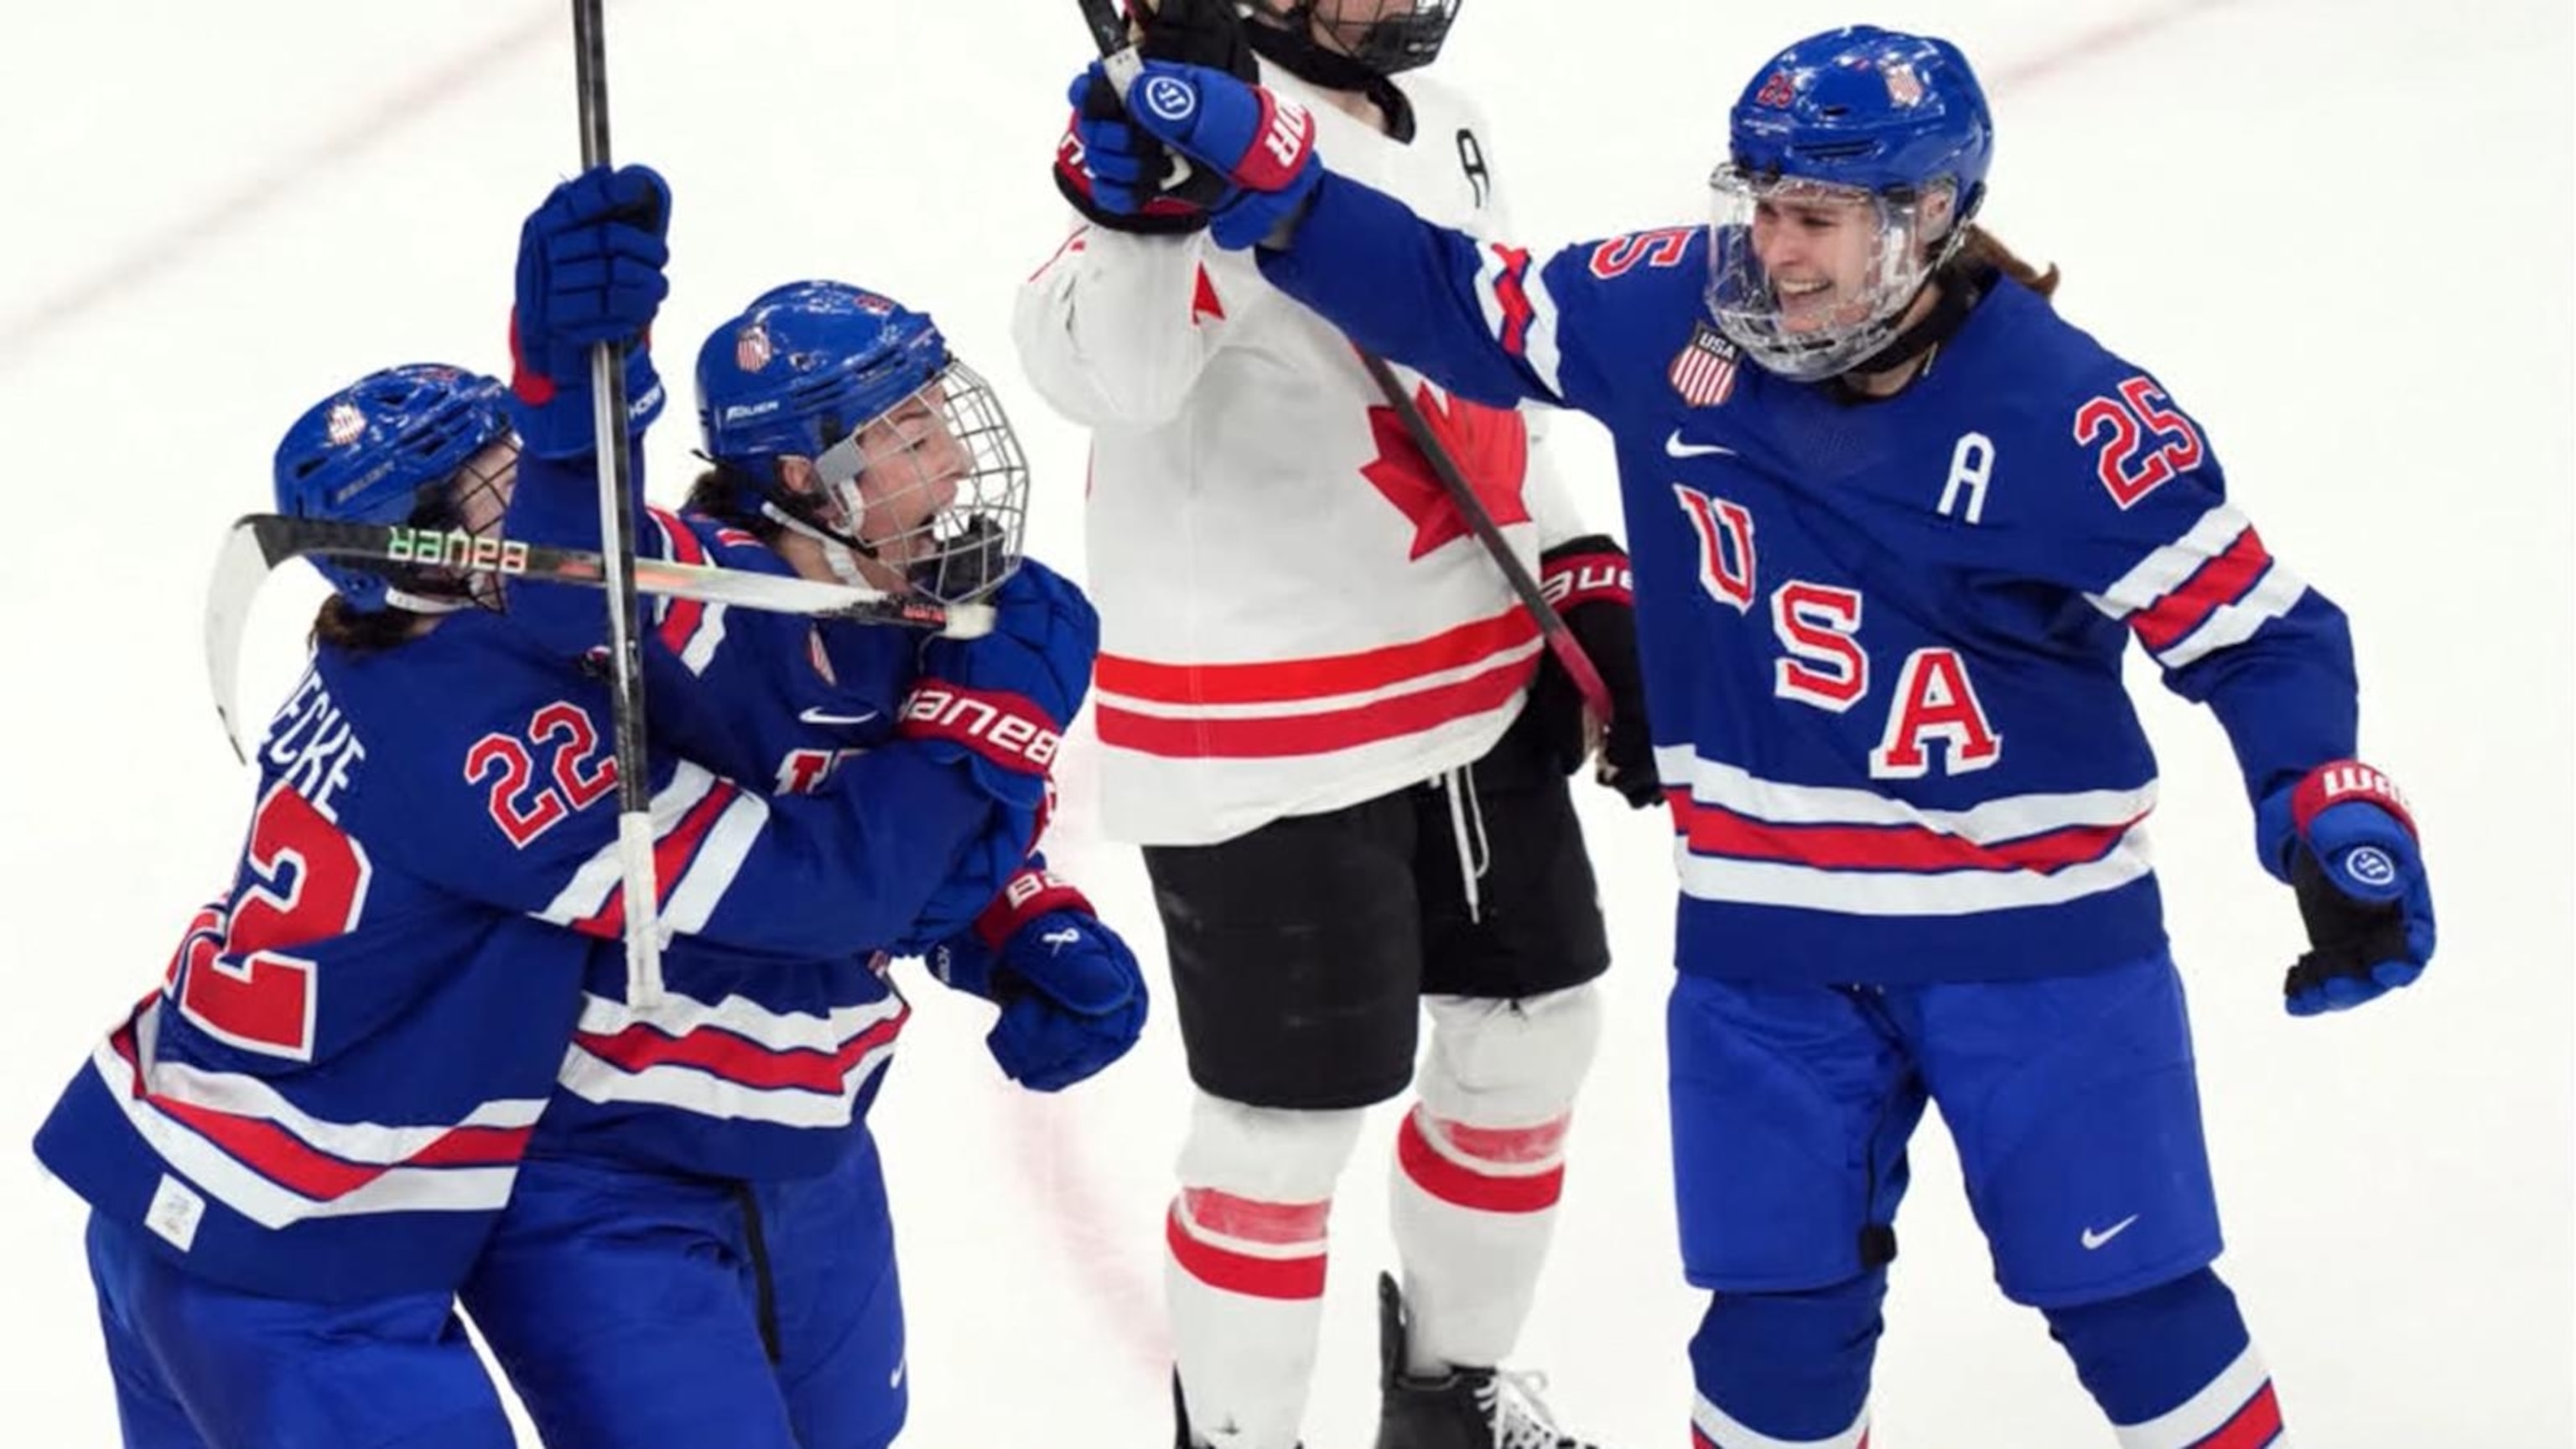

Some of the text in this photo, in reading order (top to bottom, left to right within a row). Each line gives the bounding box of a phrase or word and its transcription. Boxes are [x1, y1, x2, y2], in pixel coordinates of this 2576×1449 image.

[1455, 127, 1491, 210] A
[1698, 330, 1736, 361] USA
[1936, 430, 1997, 525] A
[2074, 374, 2203, 509] 25
[1672, 481, 2003, 780] USA
[463, 699, 621, 850] 22
